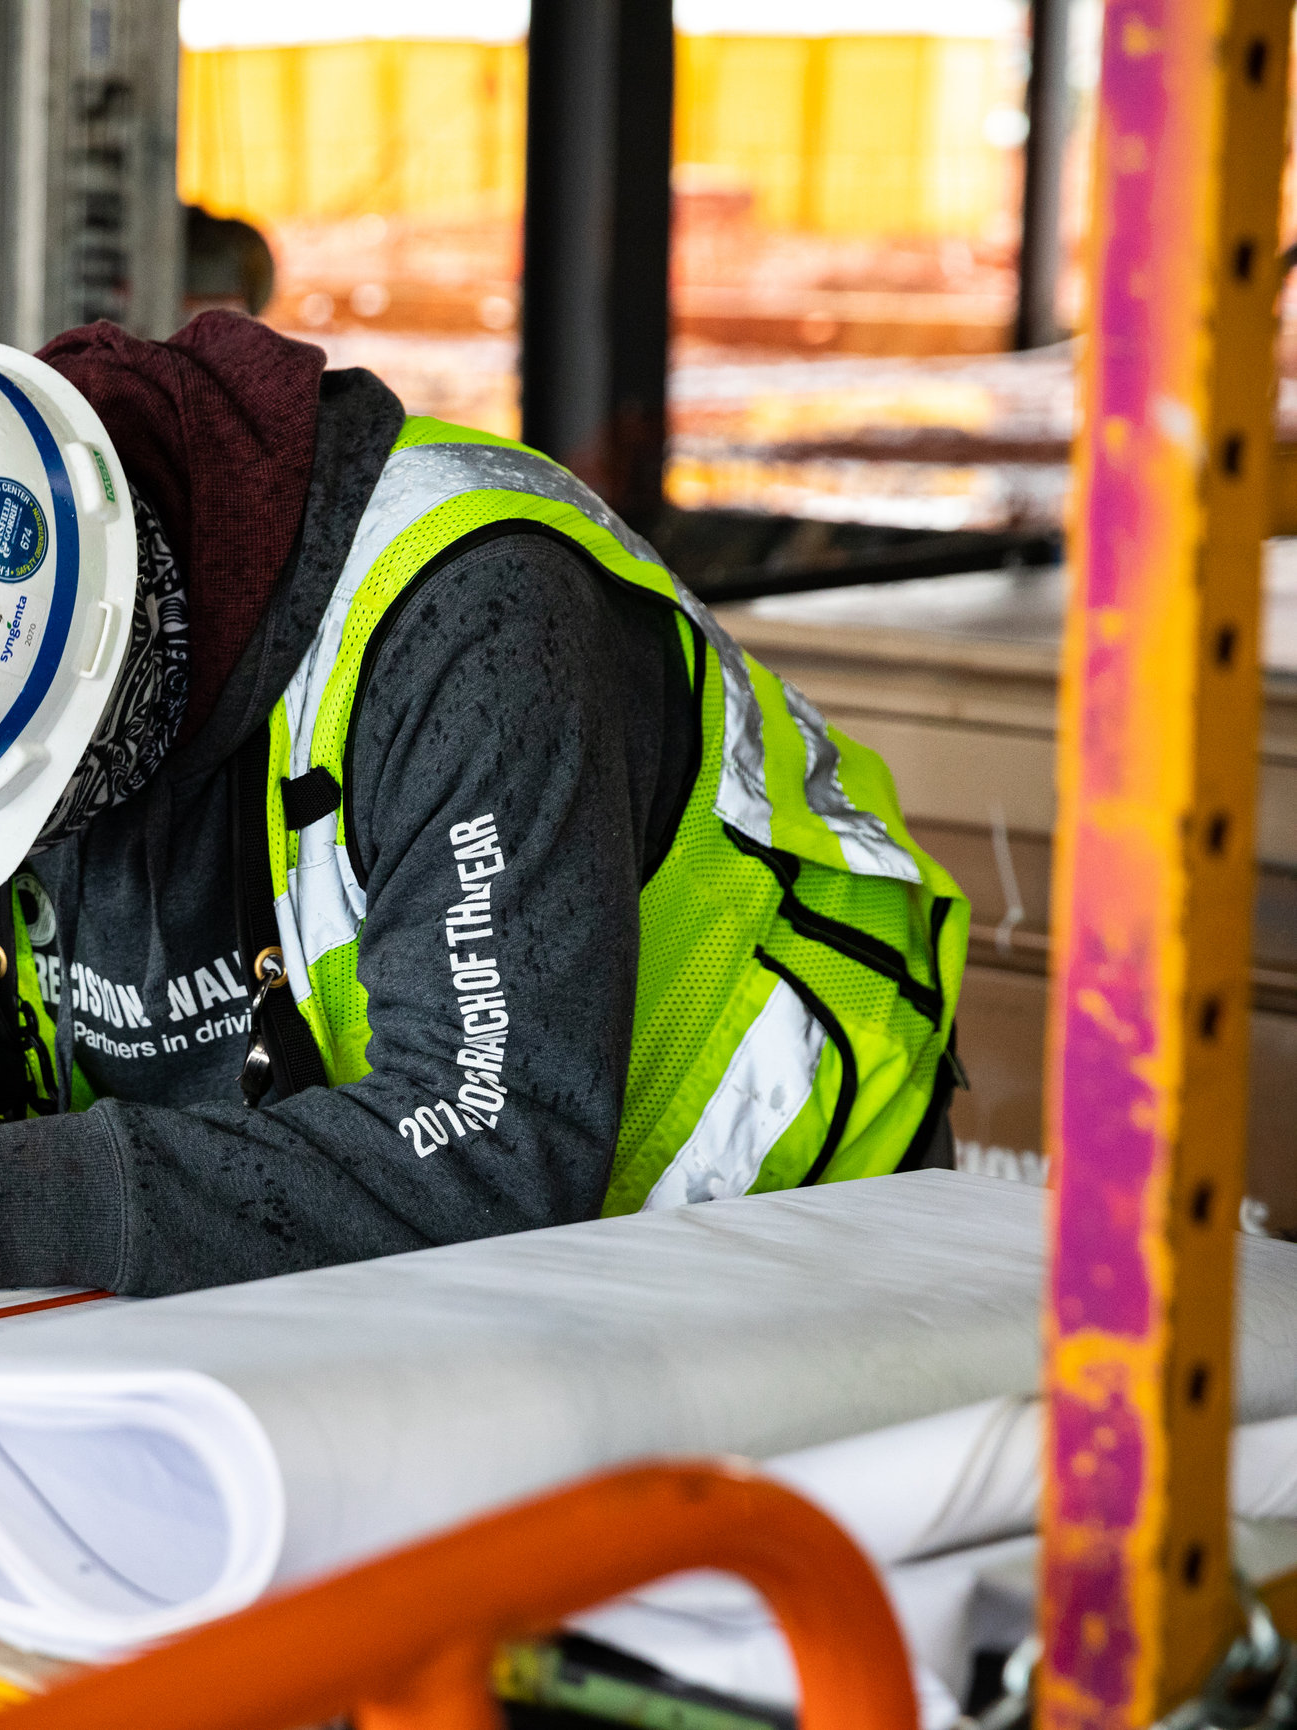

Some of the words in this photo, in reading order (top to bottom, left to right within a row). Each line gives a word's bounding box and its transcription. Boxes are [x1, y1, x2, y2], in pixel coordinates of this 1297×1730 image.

[2, 482, 31, 505] CENTER
[3, 501, 19, 541] GORRIE
[20, 527, 33, 550] 674
[16, 556, 37, 576] SAFETY
[32, 507, 45, 559] ORIENTATION
[0, 595, 27, 663] syngenta
[25, 623, 37, 647] 2070
[33, 952, 152, 1029] RECISION
[449, 952, 501, 991] OF
[74, 1020, 157, 1059] Partners
[161, 1034, 189, 1053] in
[195, 1008, 252, 1043] drivi
